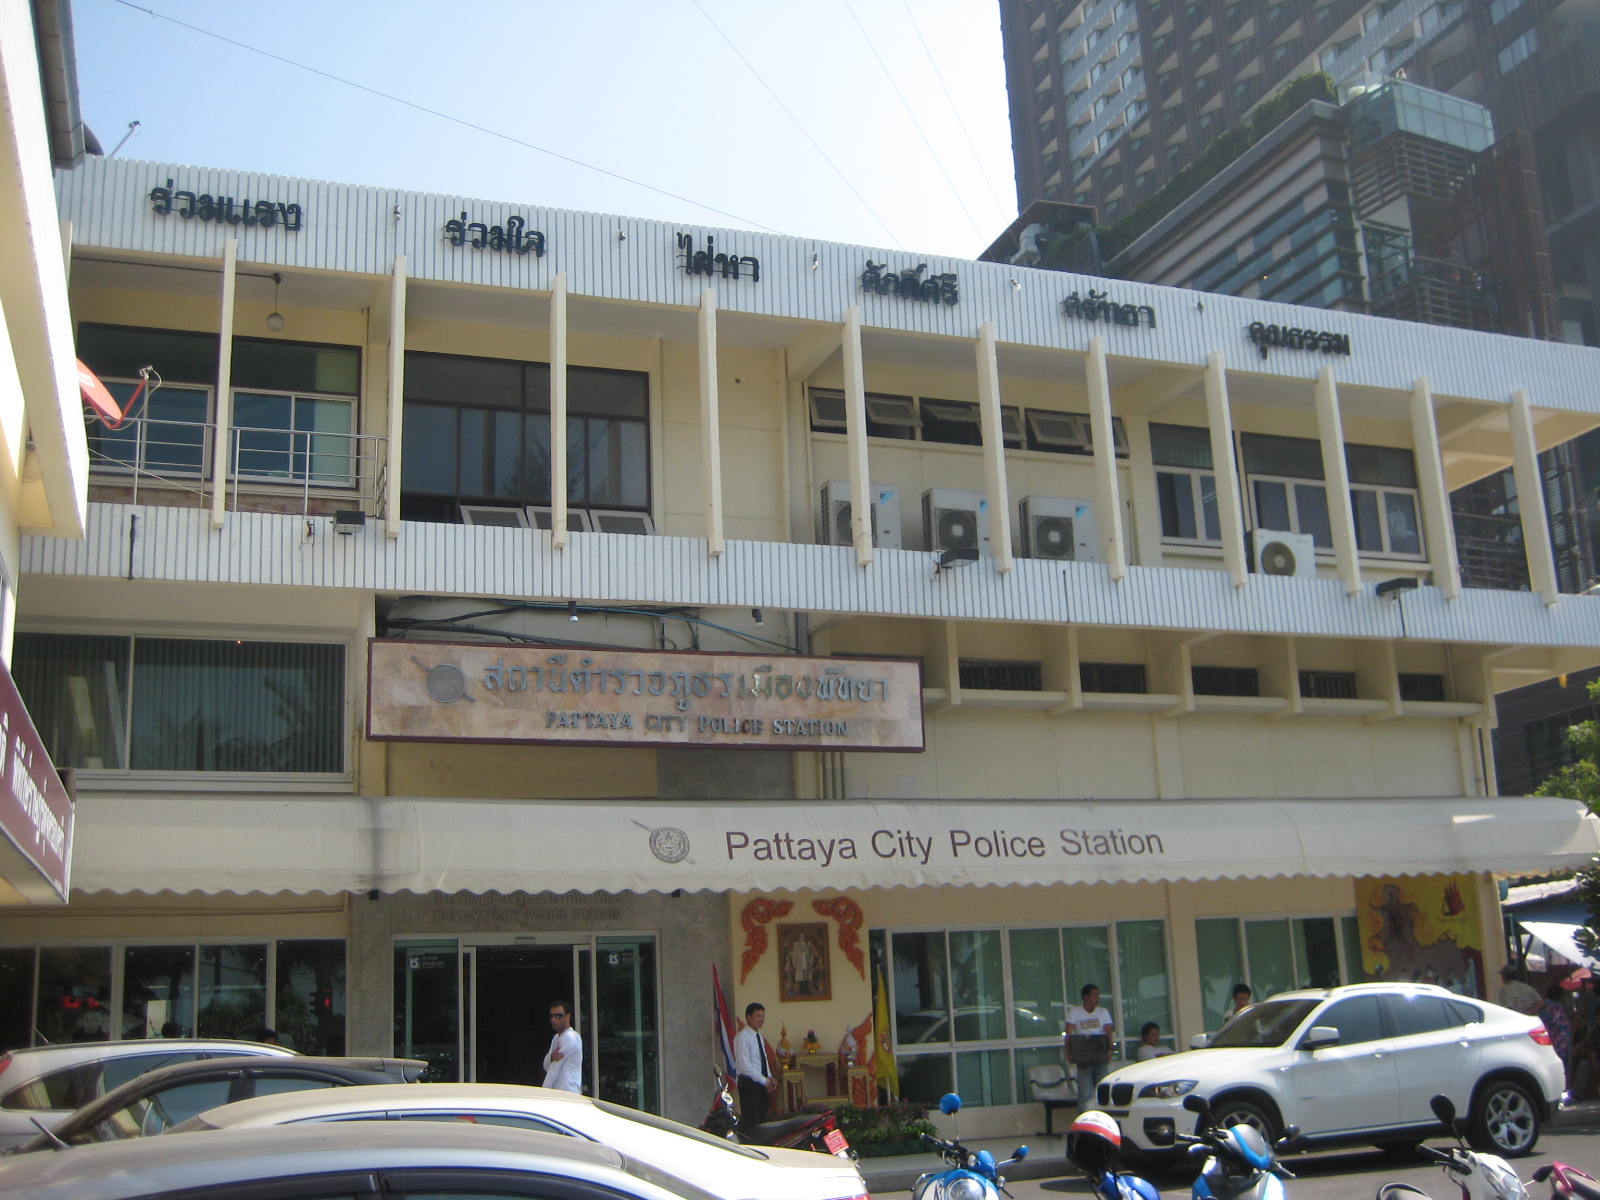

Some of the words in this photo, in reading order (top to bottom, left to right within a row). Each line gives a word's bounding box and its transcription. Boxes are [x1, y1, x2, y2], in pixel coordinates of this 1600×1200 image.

[445, 211, 545, 258] ร่วมใจ
[545, 710, 633, 730] PATTAYA
[645, 713, 689, 732] CITY
[697, 715, 763, 735] POLICE
[772, 718, 849, 737] STATION
[725, 829, 858, 868] Pattaya
[871, 828, 934, 865] City
[950, 828, 1046, 859] Police
[1059, 827, 1164, 857] Station
